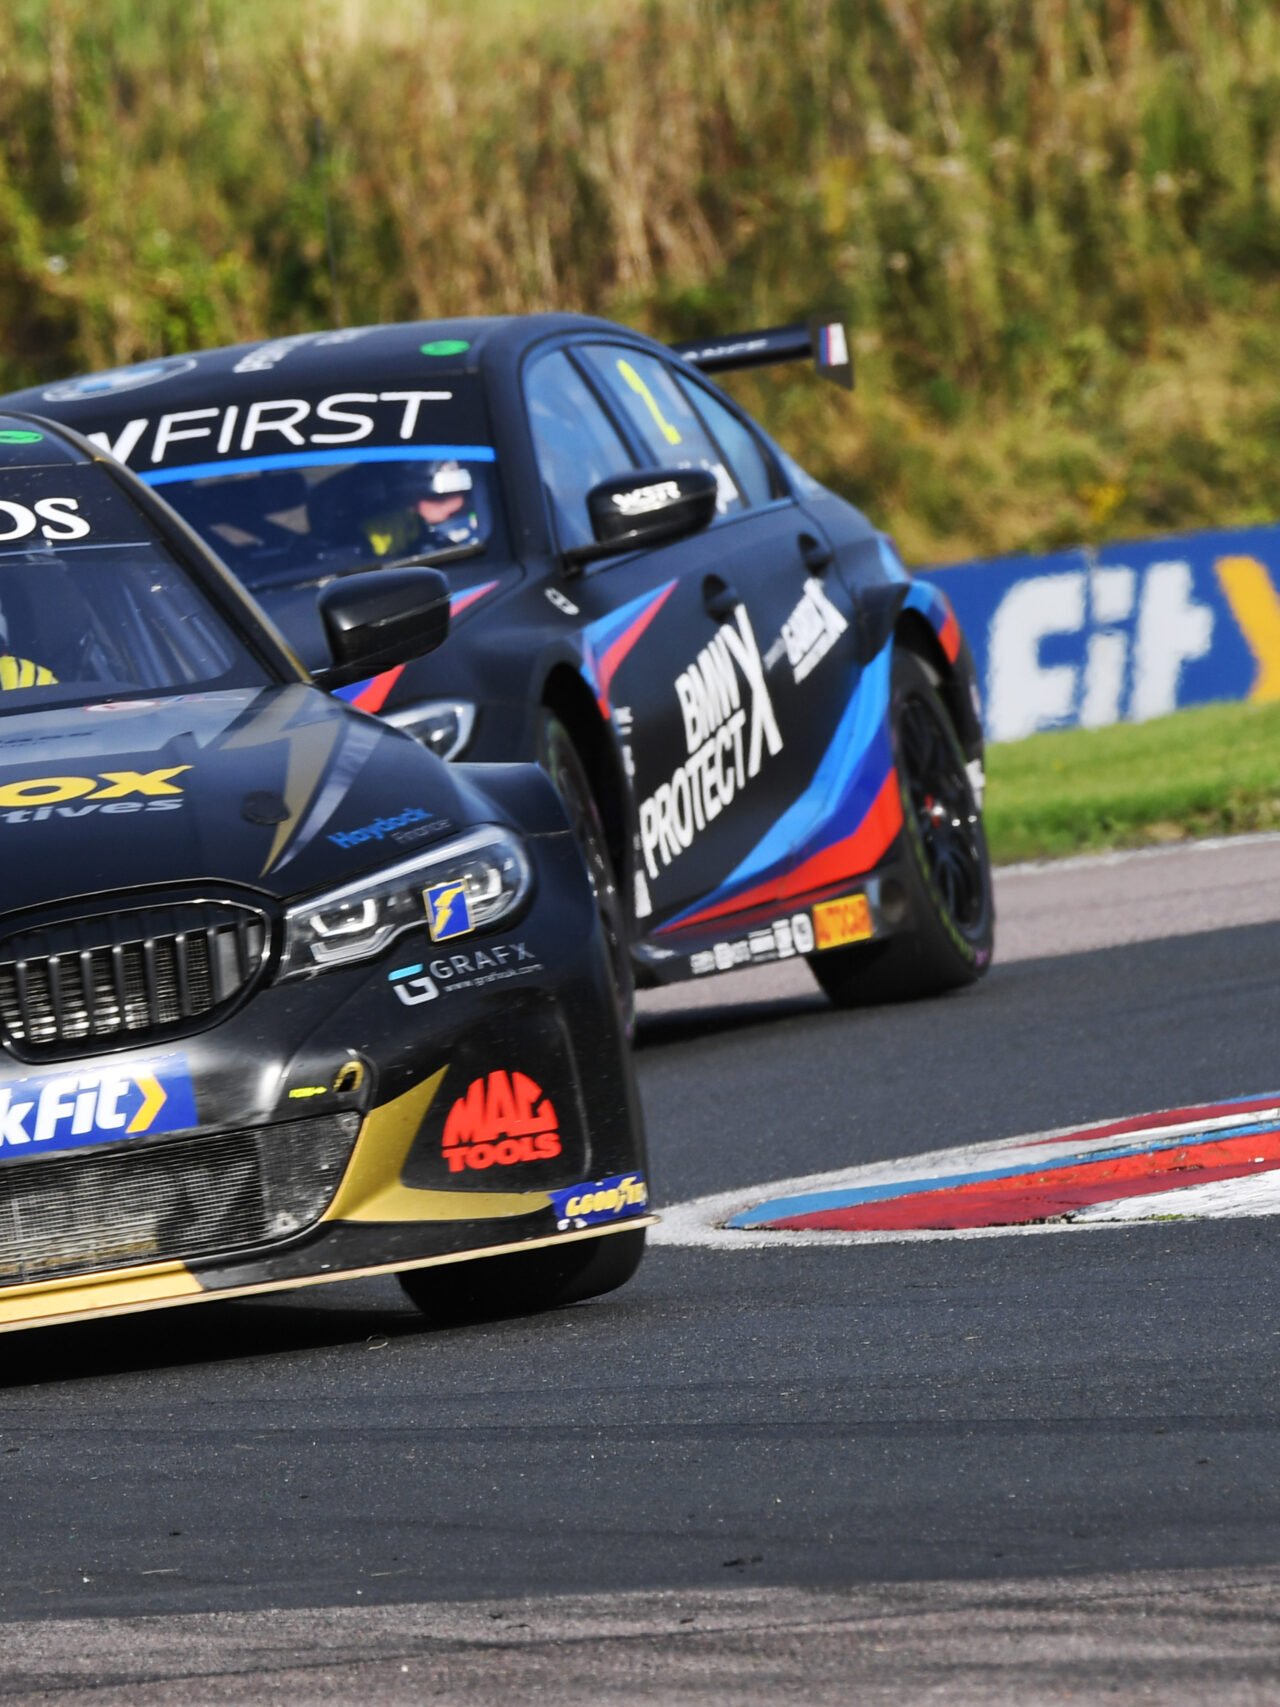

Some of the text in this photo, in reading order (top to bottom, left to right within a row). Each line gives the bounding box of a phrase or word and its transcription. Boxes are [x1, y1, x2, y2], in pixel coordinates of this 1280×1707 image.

[675, 630, 742, 755] BMW
[639, 710, 747, 879] PROTECT
[326, 807, 434, 849] Haydock
[429, 942, 536, 980] GRAFX
[441, 1069, 559, 1148] MAC
[441, 1133, 563, 1174] TOOLS
